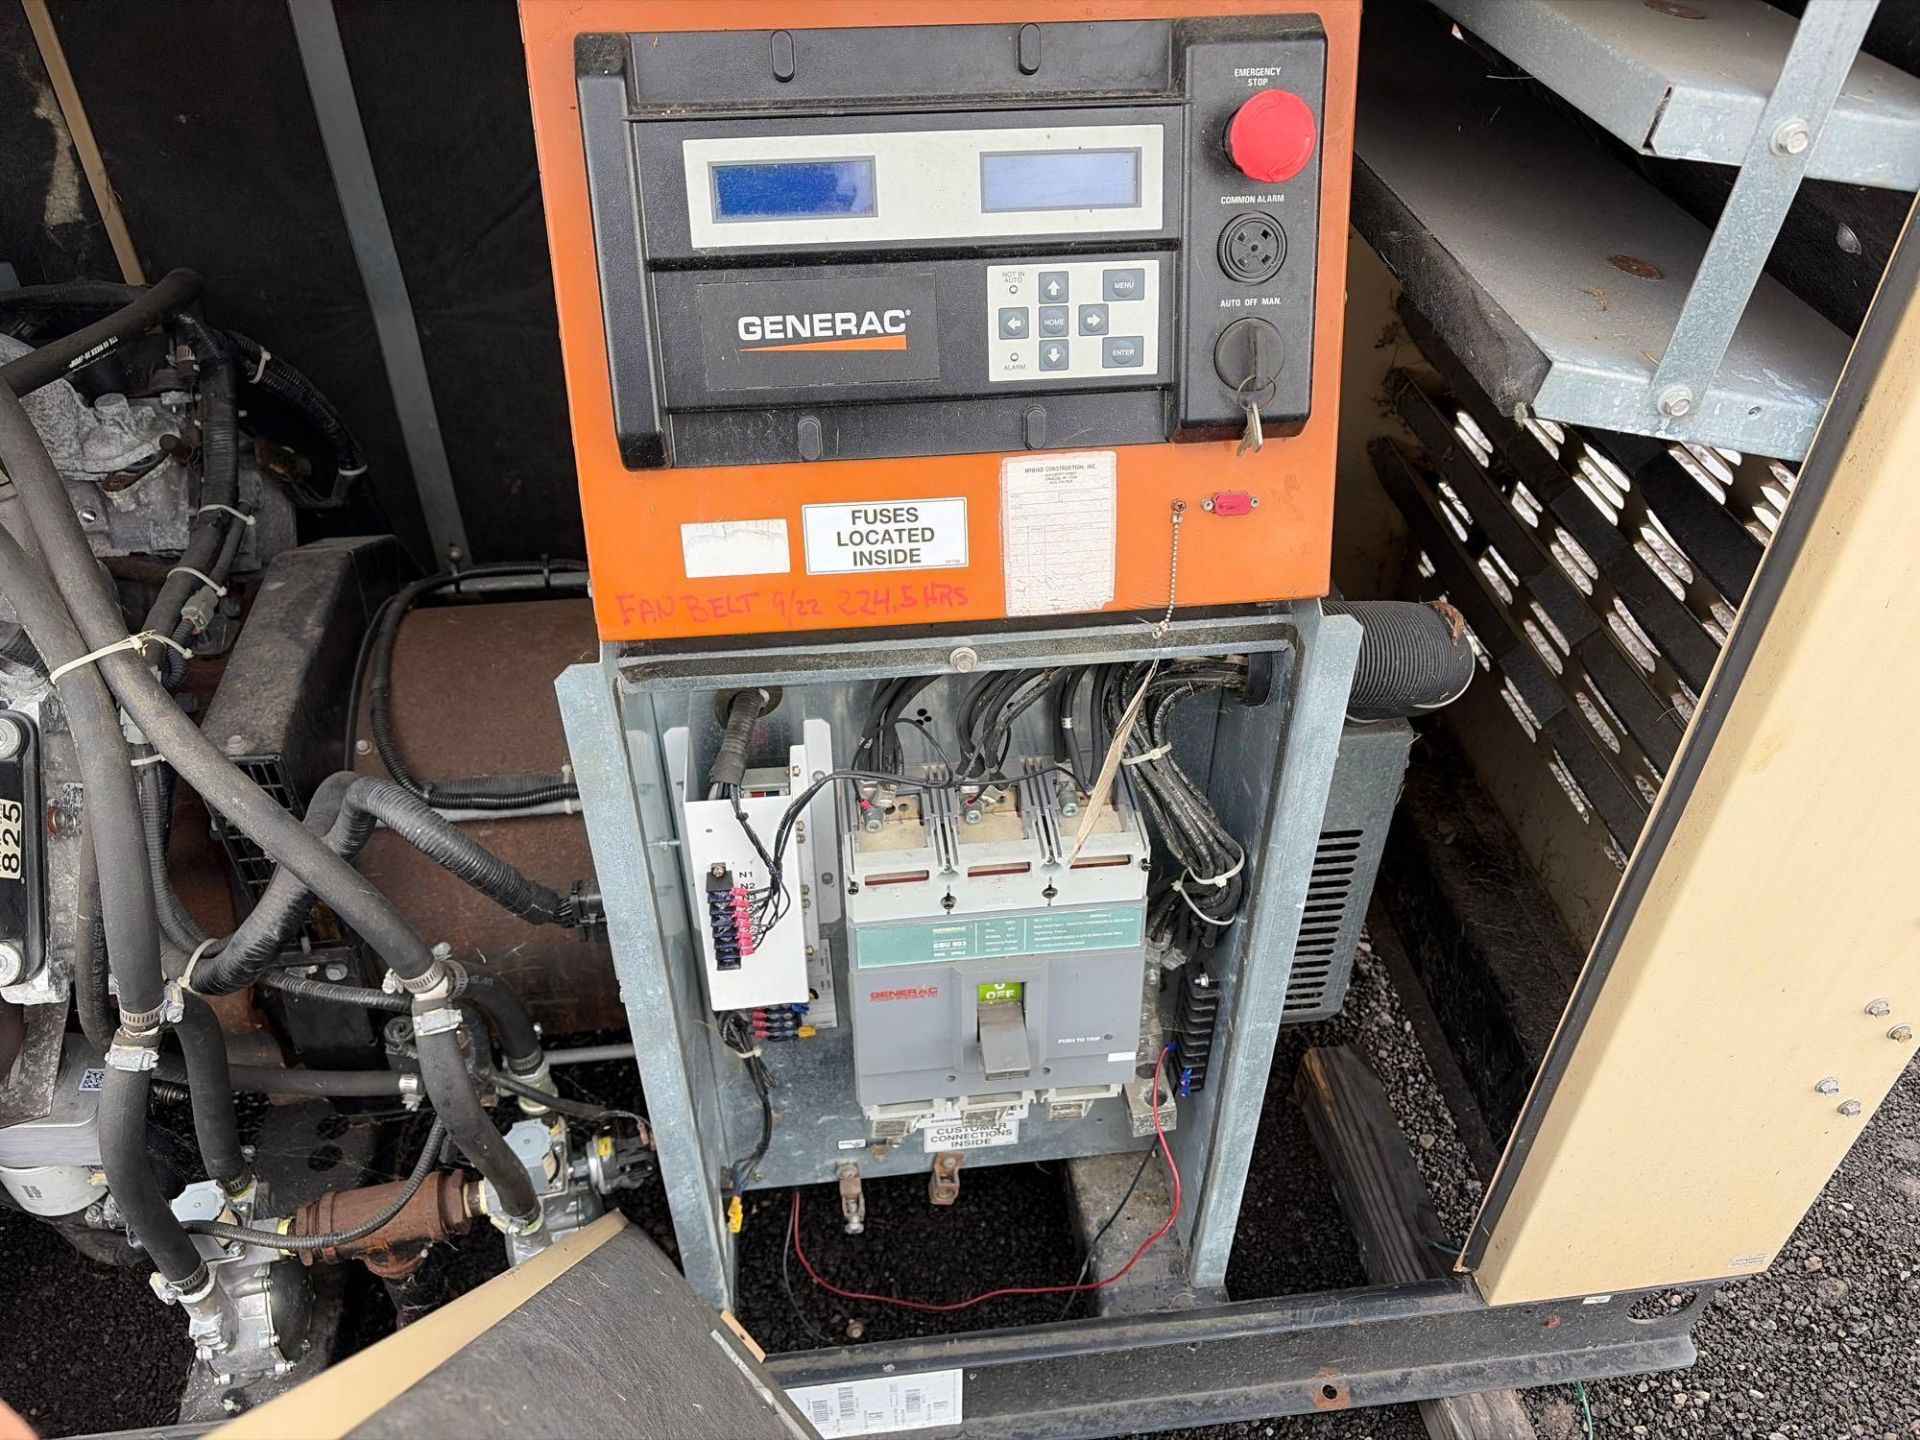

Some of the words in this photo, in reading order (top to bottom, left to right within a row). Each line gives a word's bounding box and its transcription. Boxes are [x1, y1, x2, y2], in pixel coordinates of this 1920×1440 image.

[1234, 67, 1281, 77] EMERGENCY
[1247, 78, 1269, 87] STOP
[1221, 196, 1256, 205] COMMON
[1257, 194, 1285, 203] ALARM
[1114, 281, 1135, 289] MENU
[1220, 299, 1241, 308] AUTO
[1244, 298, 1258, 306] OFF
[737, 309, 906, 341] GENERAC
[1043, 317, 1065, 326] HOME
[1112, 348, 1135, 356] ENTER
[1004, 363, 1026, 371] ALARM
[851, 507, 919, 526] FUSES
[836, 527, 935, 547] LOCATED
[853, 548, 922, 566] INSIDE
[615, 594, 675, 625] FAN
[680, 592, 760, 623] BELT
[923, 582, 969, 607] HRS
[2, 803, 21, 874] 825
[869, 987, 939, 999] GENERAC
[986, 990, 1015, 1000] OFF
[930, 1130, 1012, 1143] CONNECTIONS
[951, 1138, 992, 1148] INSIDE
